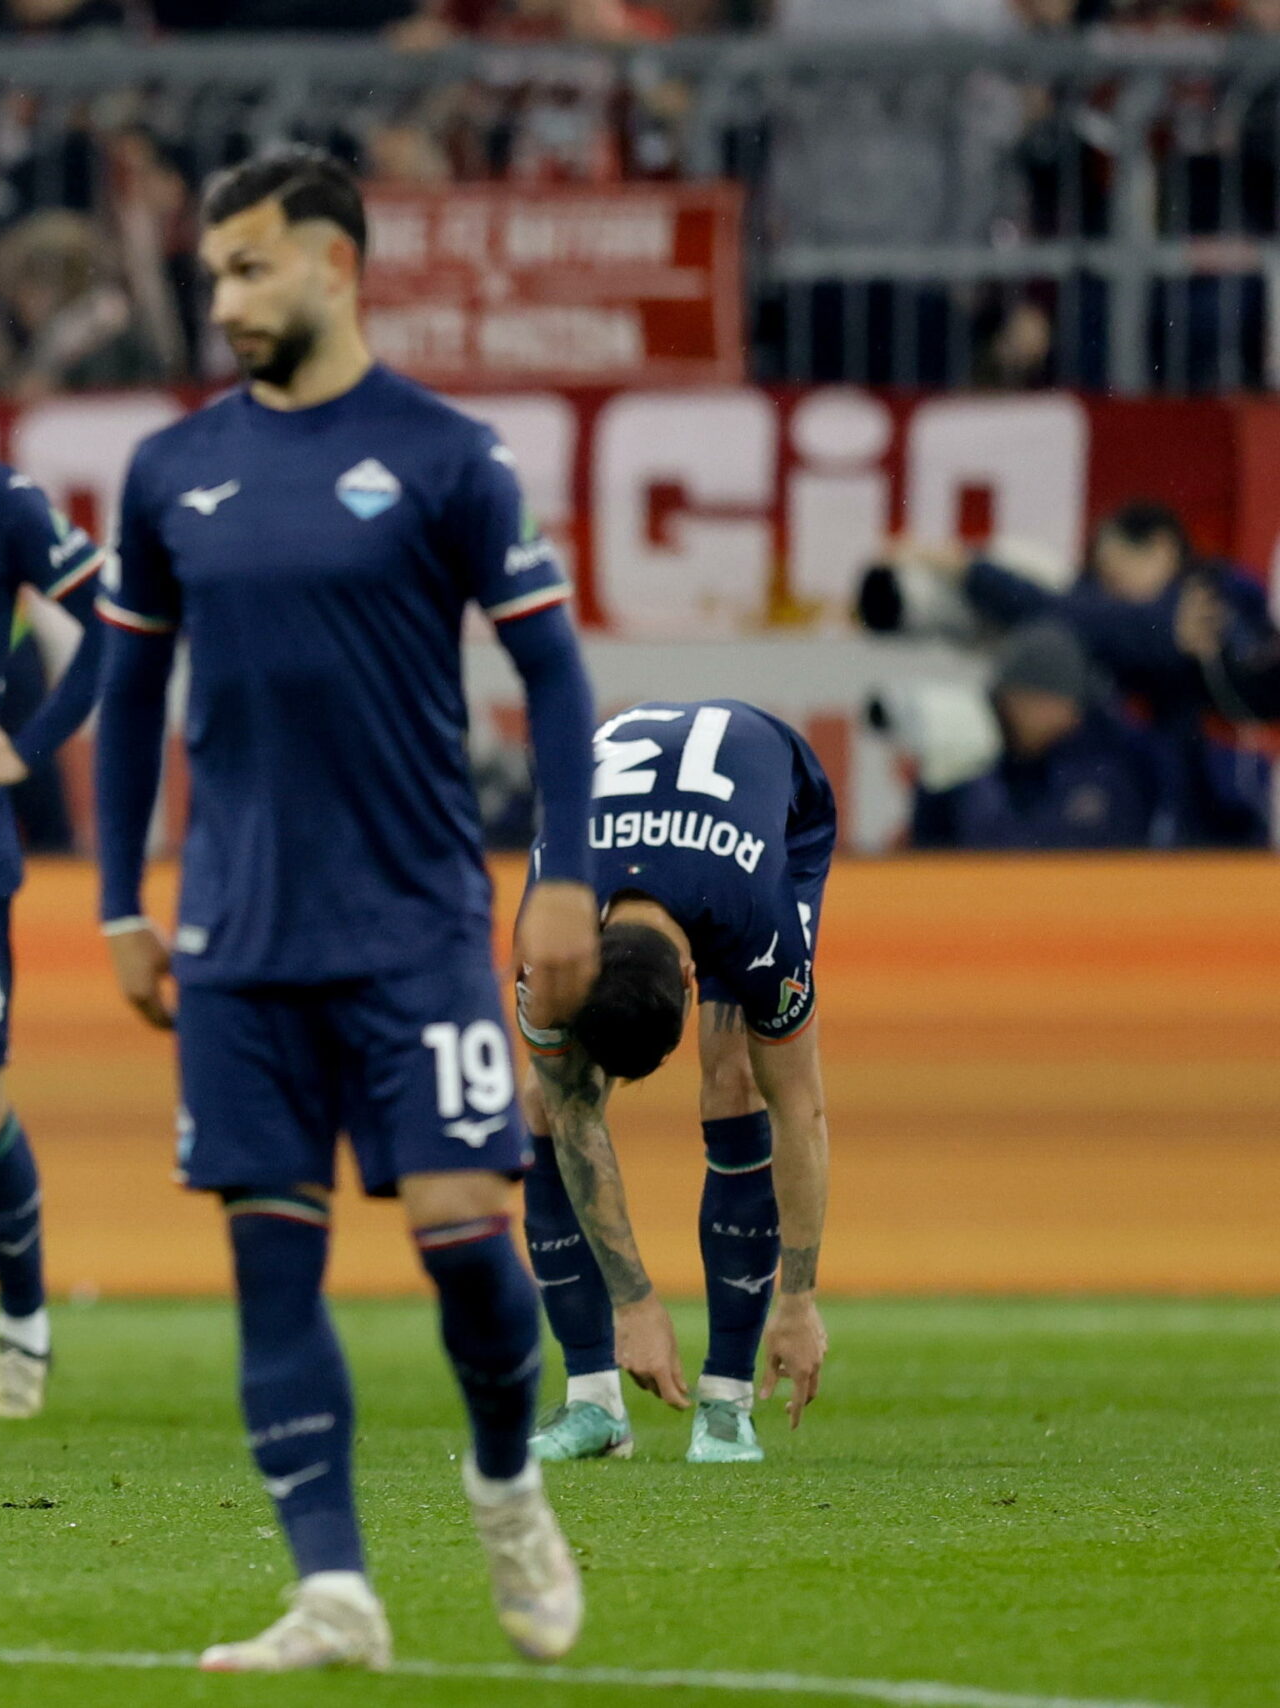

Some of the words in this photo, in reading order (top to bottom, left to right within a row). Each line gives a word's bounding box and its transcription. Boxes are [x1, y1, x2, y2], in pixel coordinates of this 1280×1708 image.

[591, 706, 735, 802] 13
[588, 811, 765, 874] ROMAGN
[421, 1019, 514, 1119] 19
